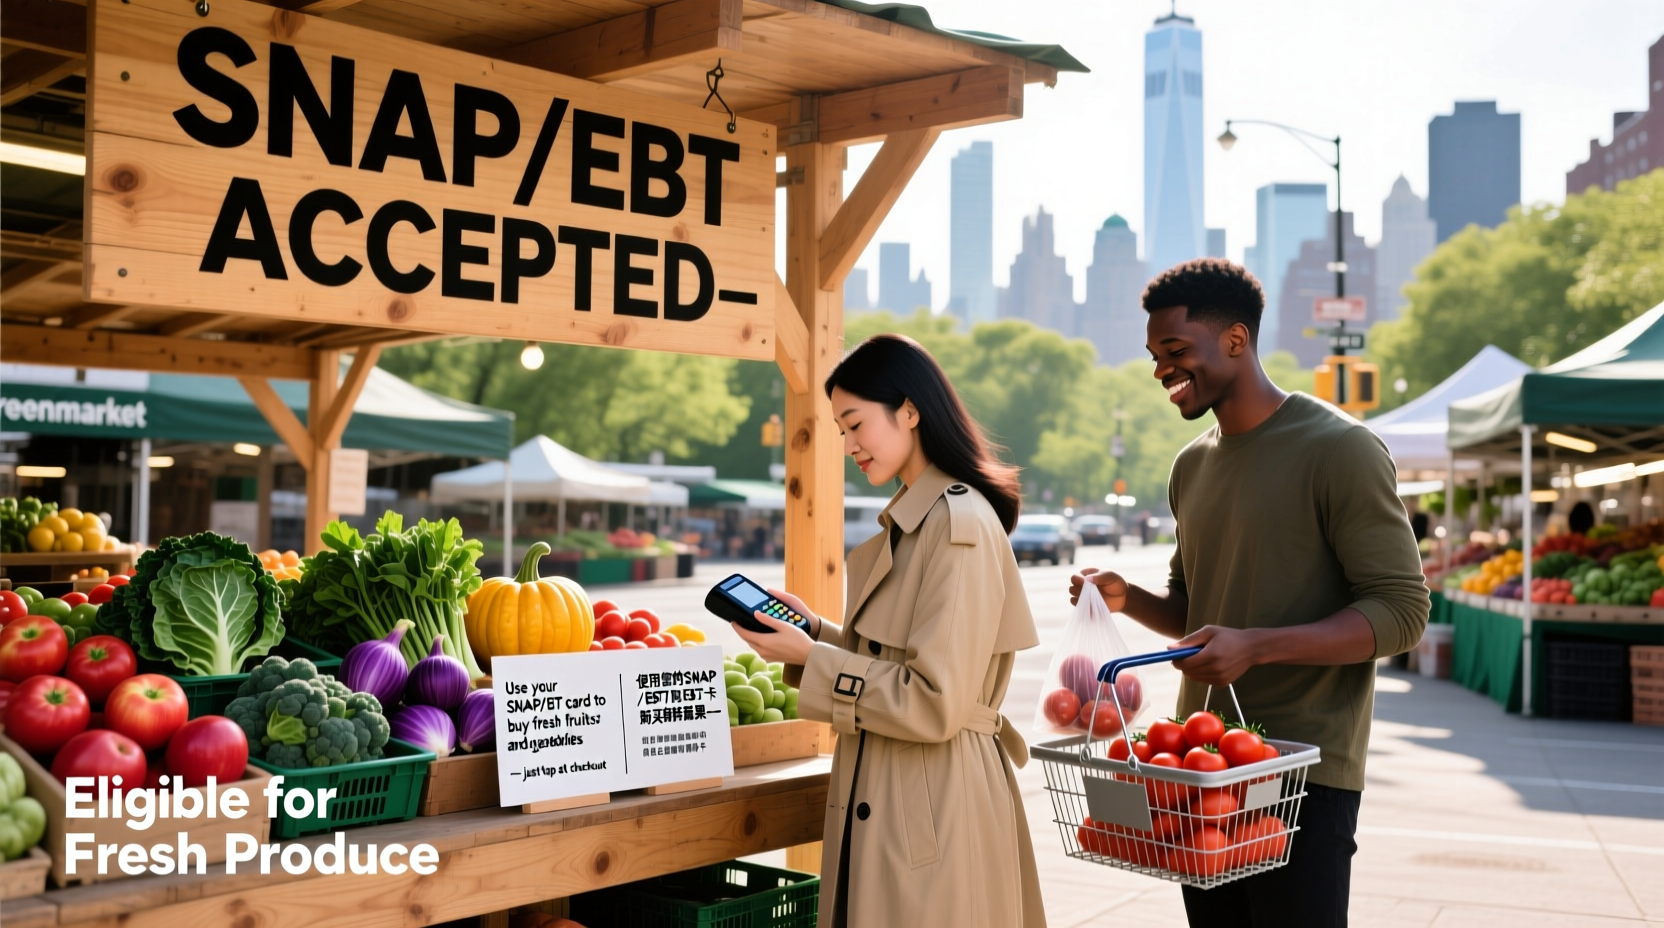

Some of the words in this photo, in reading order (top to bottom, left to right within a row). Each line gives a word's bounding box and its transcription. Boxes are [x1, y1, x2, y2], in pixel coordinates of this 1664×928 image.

[173, 26, 740, 226] SNAP/EBT
[505, 681, 528, 695] Use
[531, 682, 558, 697] your
[565, 693, 591, 709] card
[594, 694, 606, 706] to
[507, 718, 530, 735] buy
[532, 714, 561, 730] fresh
